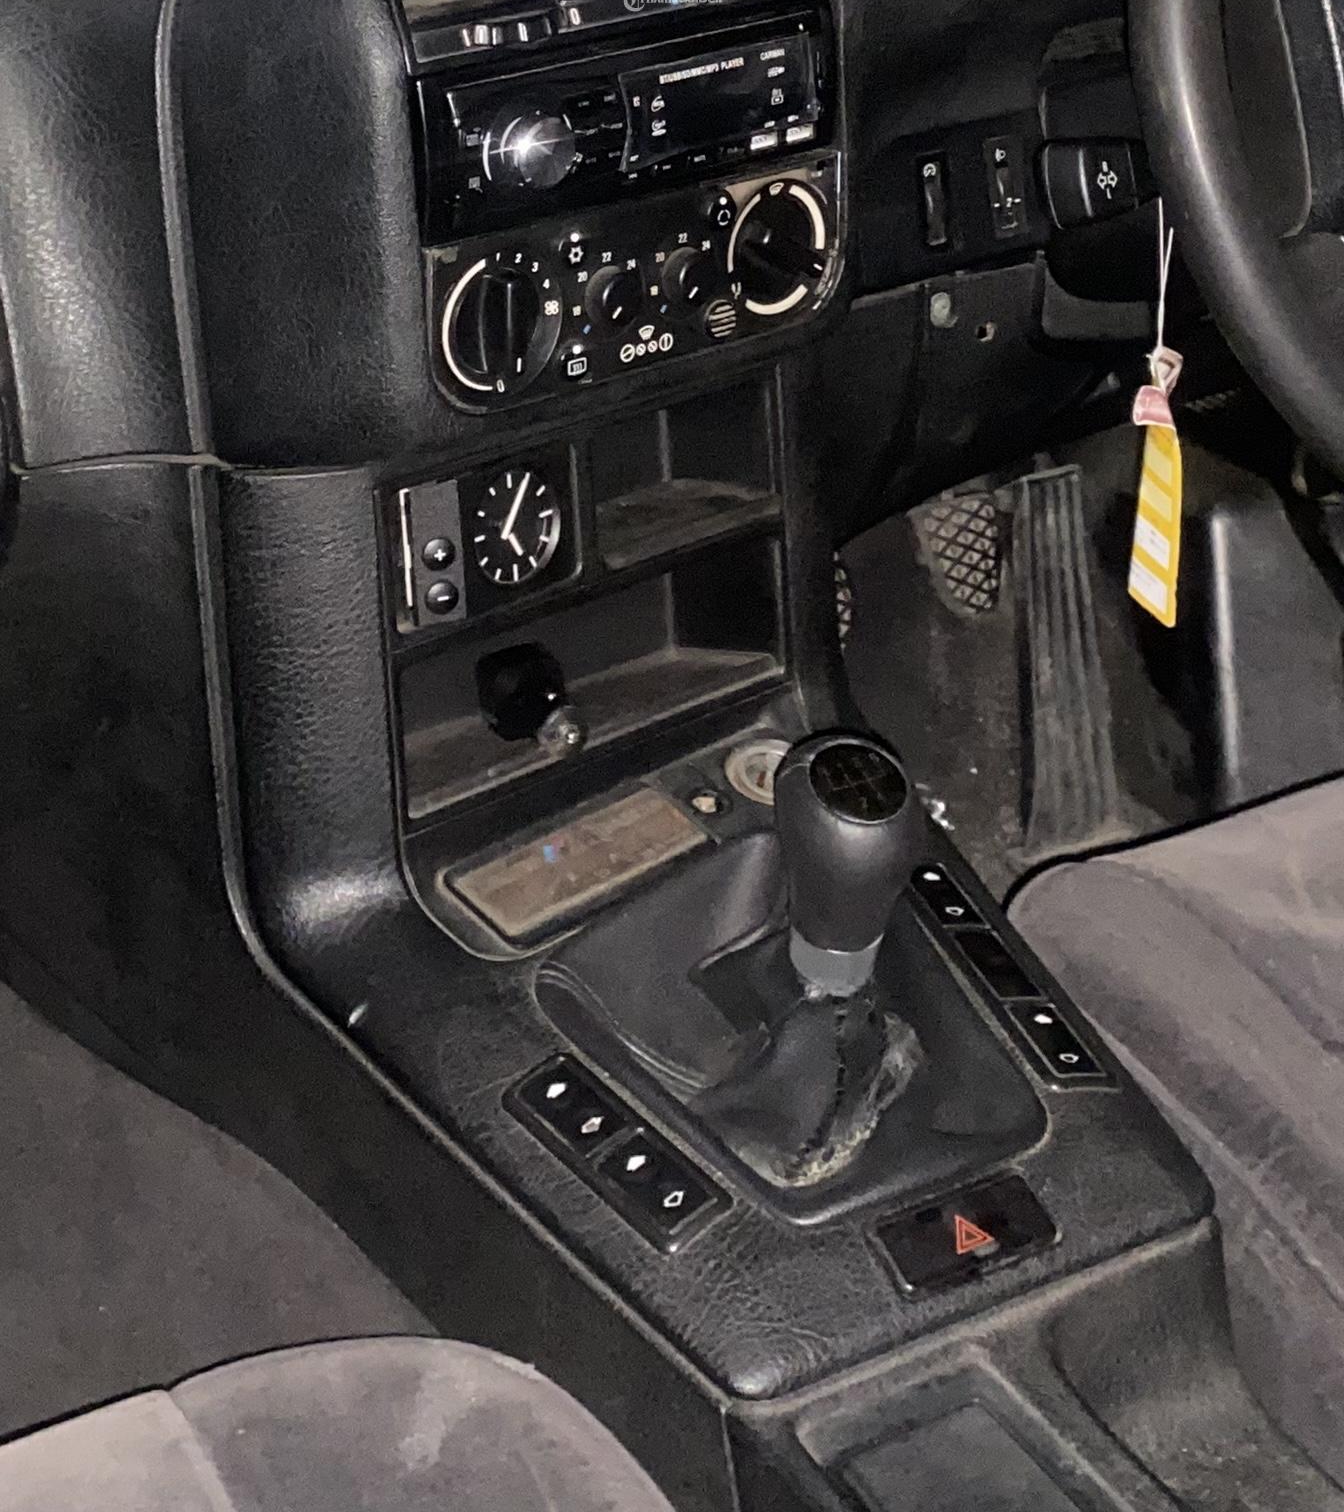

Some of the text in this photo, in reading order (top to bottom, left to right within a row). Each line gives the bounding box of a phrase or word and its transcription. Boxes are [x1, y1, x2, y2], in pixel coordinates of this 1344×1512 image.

[514, 252, 523, 264] 2
[531, 261, 539, 273] 3
[577, 270, 589, 283] 20
[542, 278, 550, 289] 4
